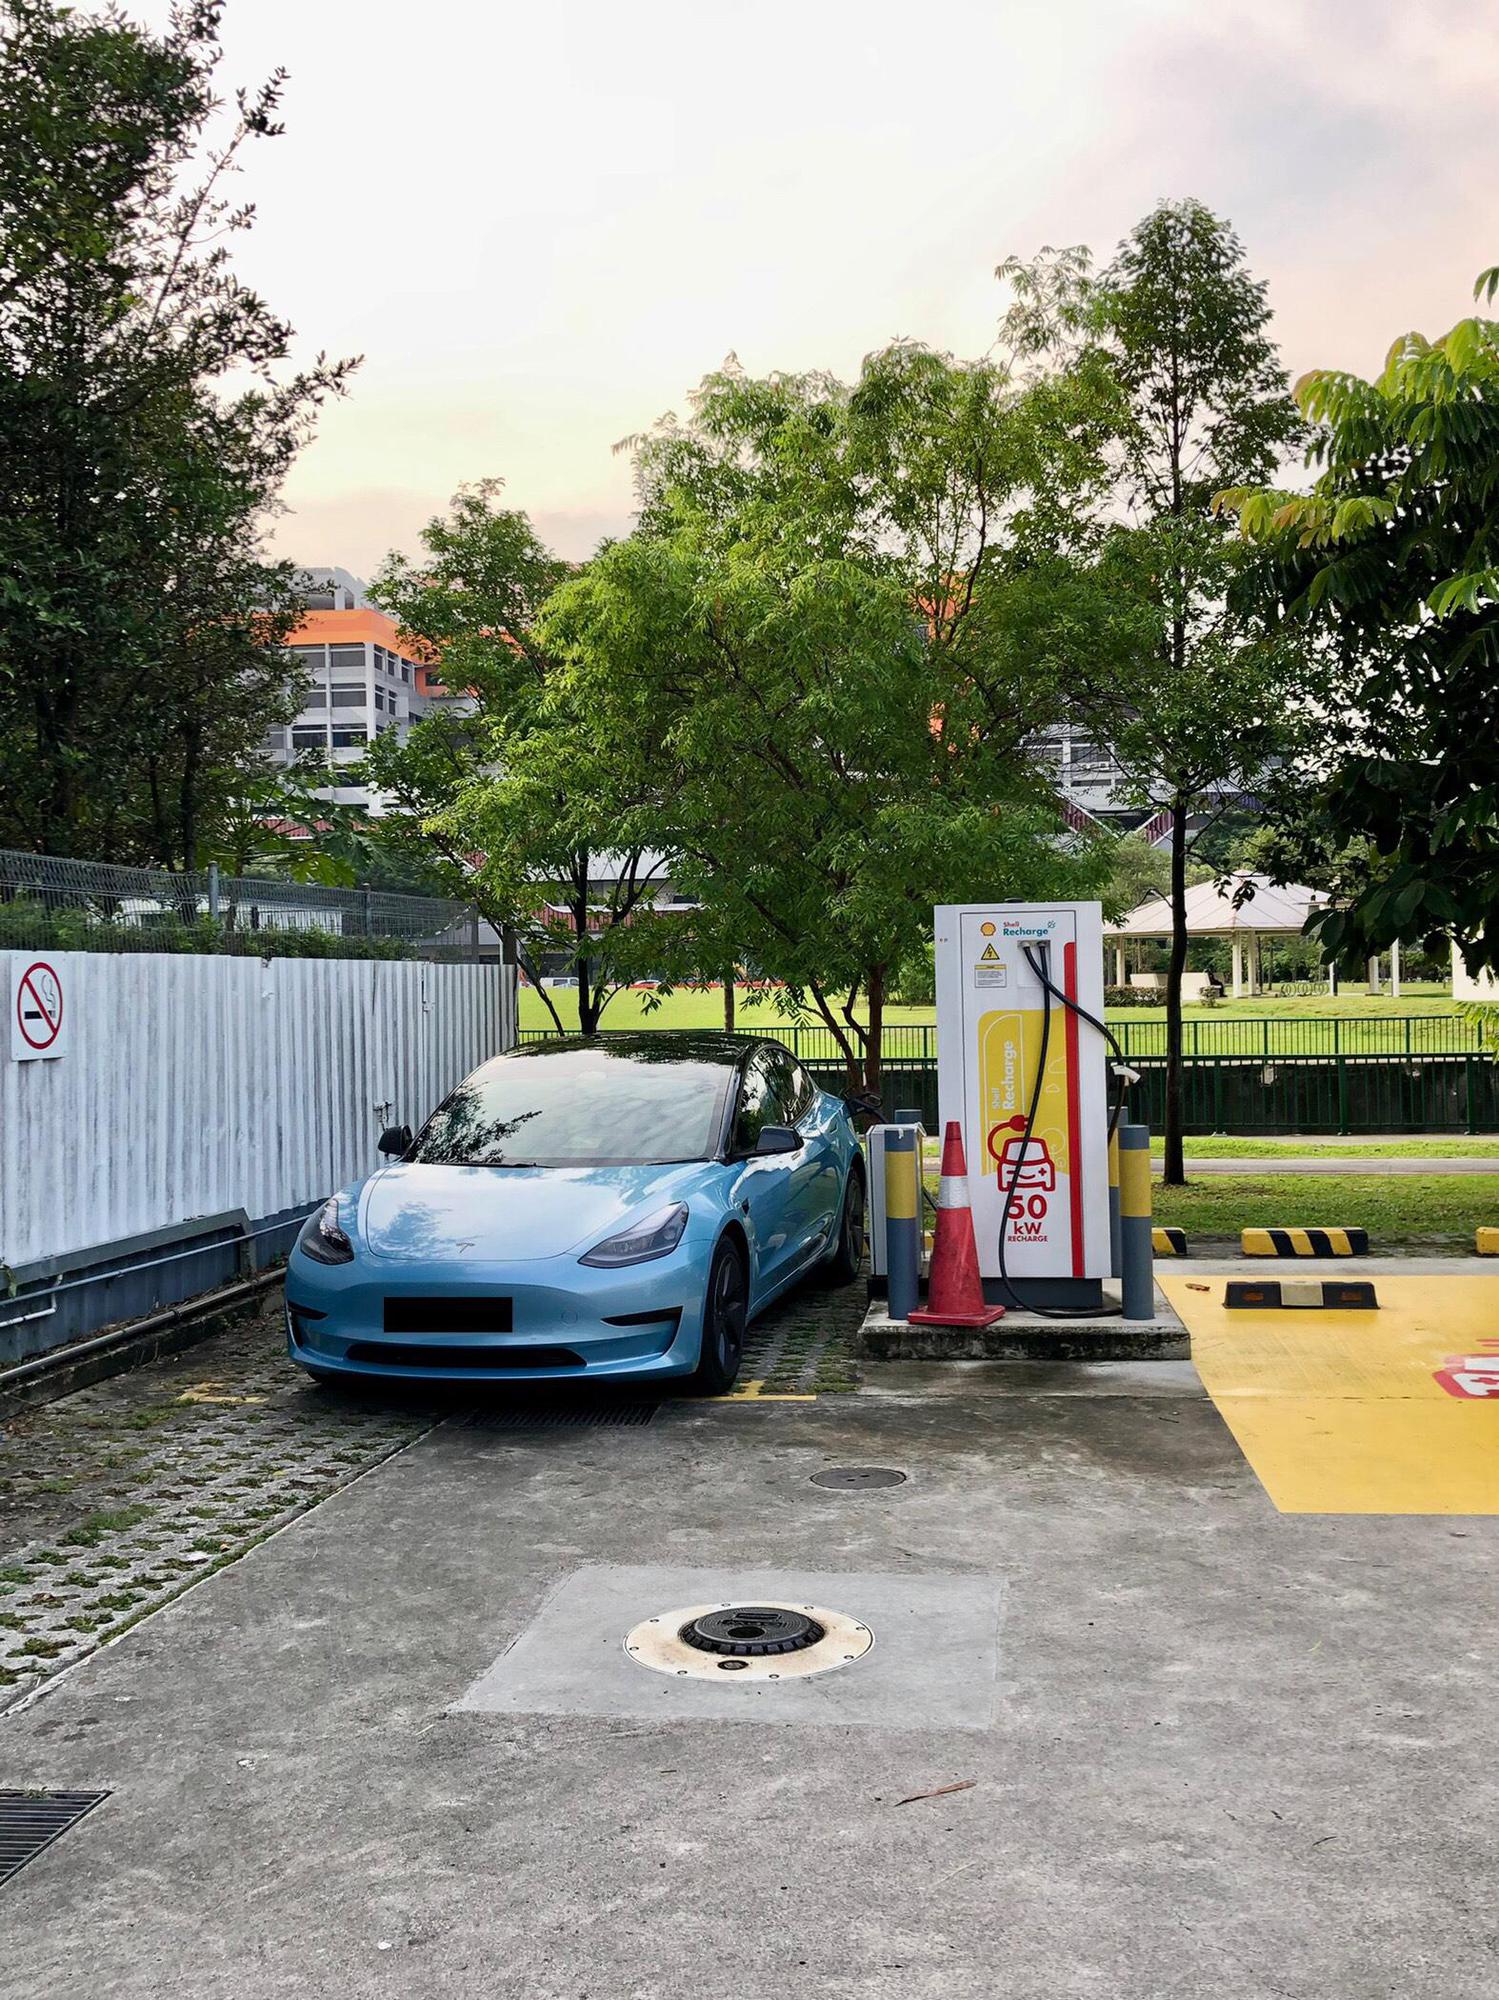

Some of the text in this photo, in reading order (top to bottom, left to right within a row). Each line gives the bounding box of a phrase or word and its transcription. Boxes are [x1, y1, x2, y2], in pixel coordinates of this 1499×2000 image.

[1003, 927, 1048, 937] Recharge
[1001, 1040, 1017, 1109] Recharge
[992, 1087, 1000, 1109] Shell
[1007, 1194, 1047, 1219] 50
[1013, 1221, 1042, 1235] kW
